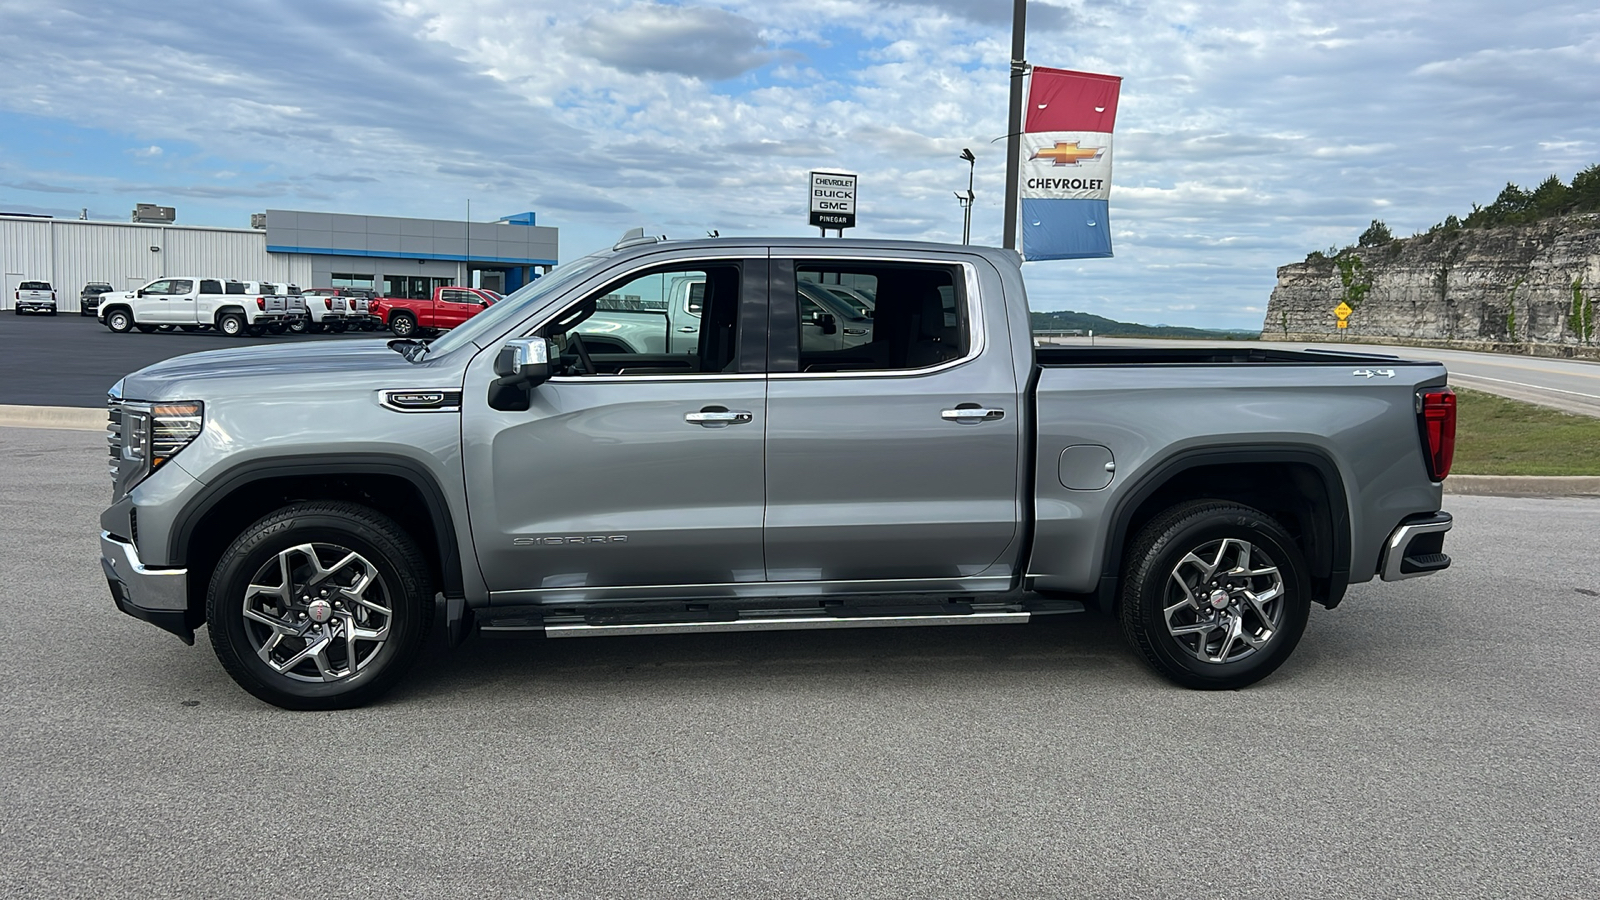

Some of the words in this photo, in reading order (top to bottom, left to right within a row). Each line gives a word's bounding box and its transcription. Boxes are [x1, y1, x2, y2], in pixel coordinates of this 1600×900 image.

[815, 178, 852, 187] CHEVROLET
[1027, 178, 1103, 190] CHEVROLET
[815, 190, 852, 199] BUICK
[820, 202, 848, 210] GMC
[513, 534, 628, 546] SIERRA
